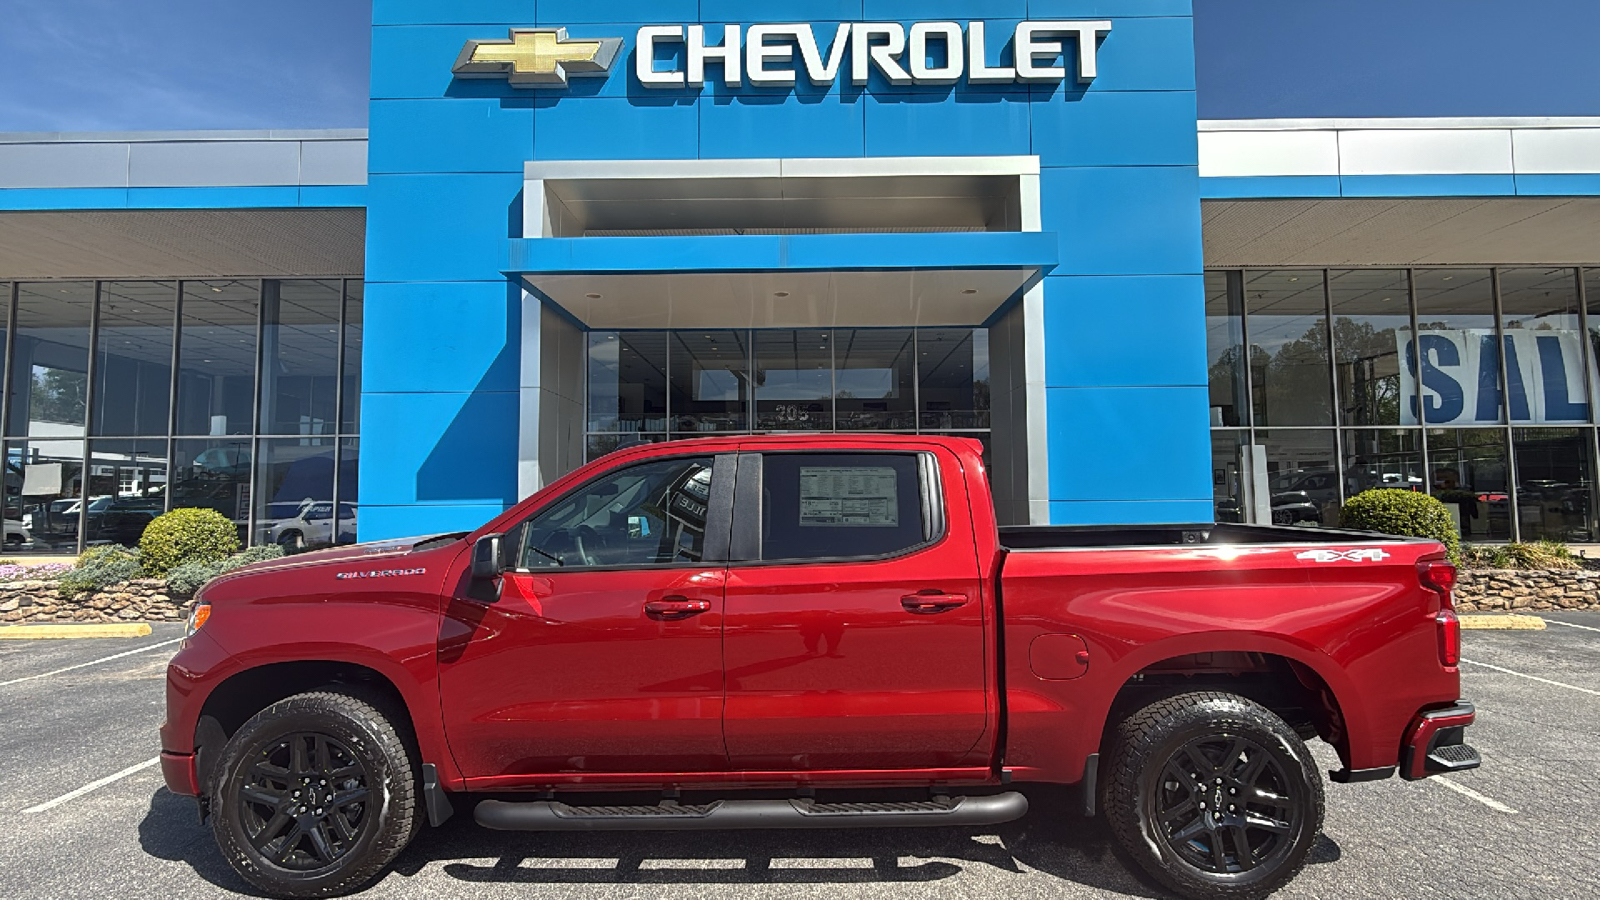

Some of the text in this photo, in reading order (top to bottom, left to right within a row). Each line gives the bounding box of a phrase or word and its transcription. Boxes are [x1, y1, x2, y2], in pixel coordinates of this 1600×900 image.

[636, 20, 1112, 87] CHEVROLET
[775, 404, 809, 421] 205
[336, 567, 427, 579] SILVERADO
